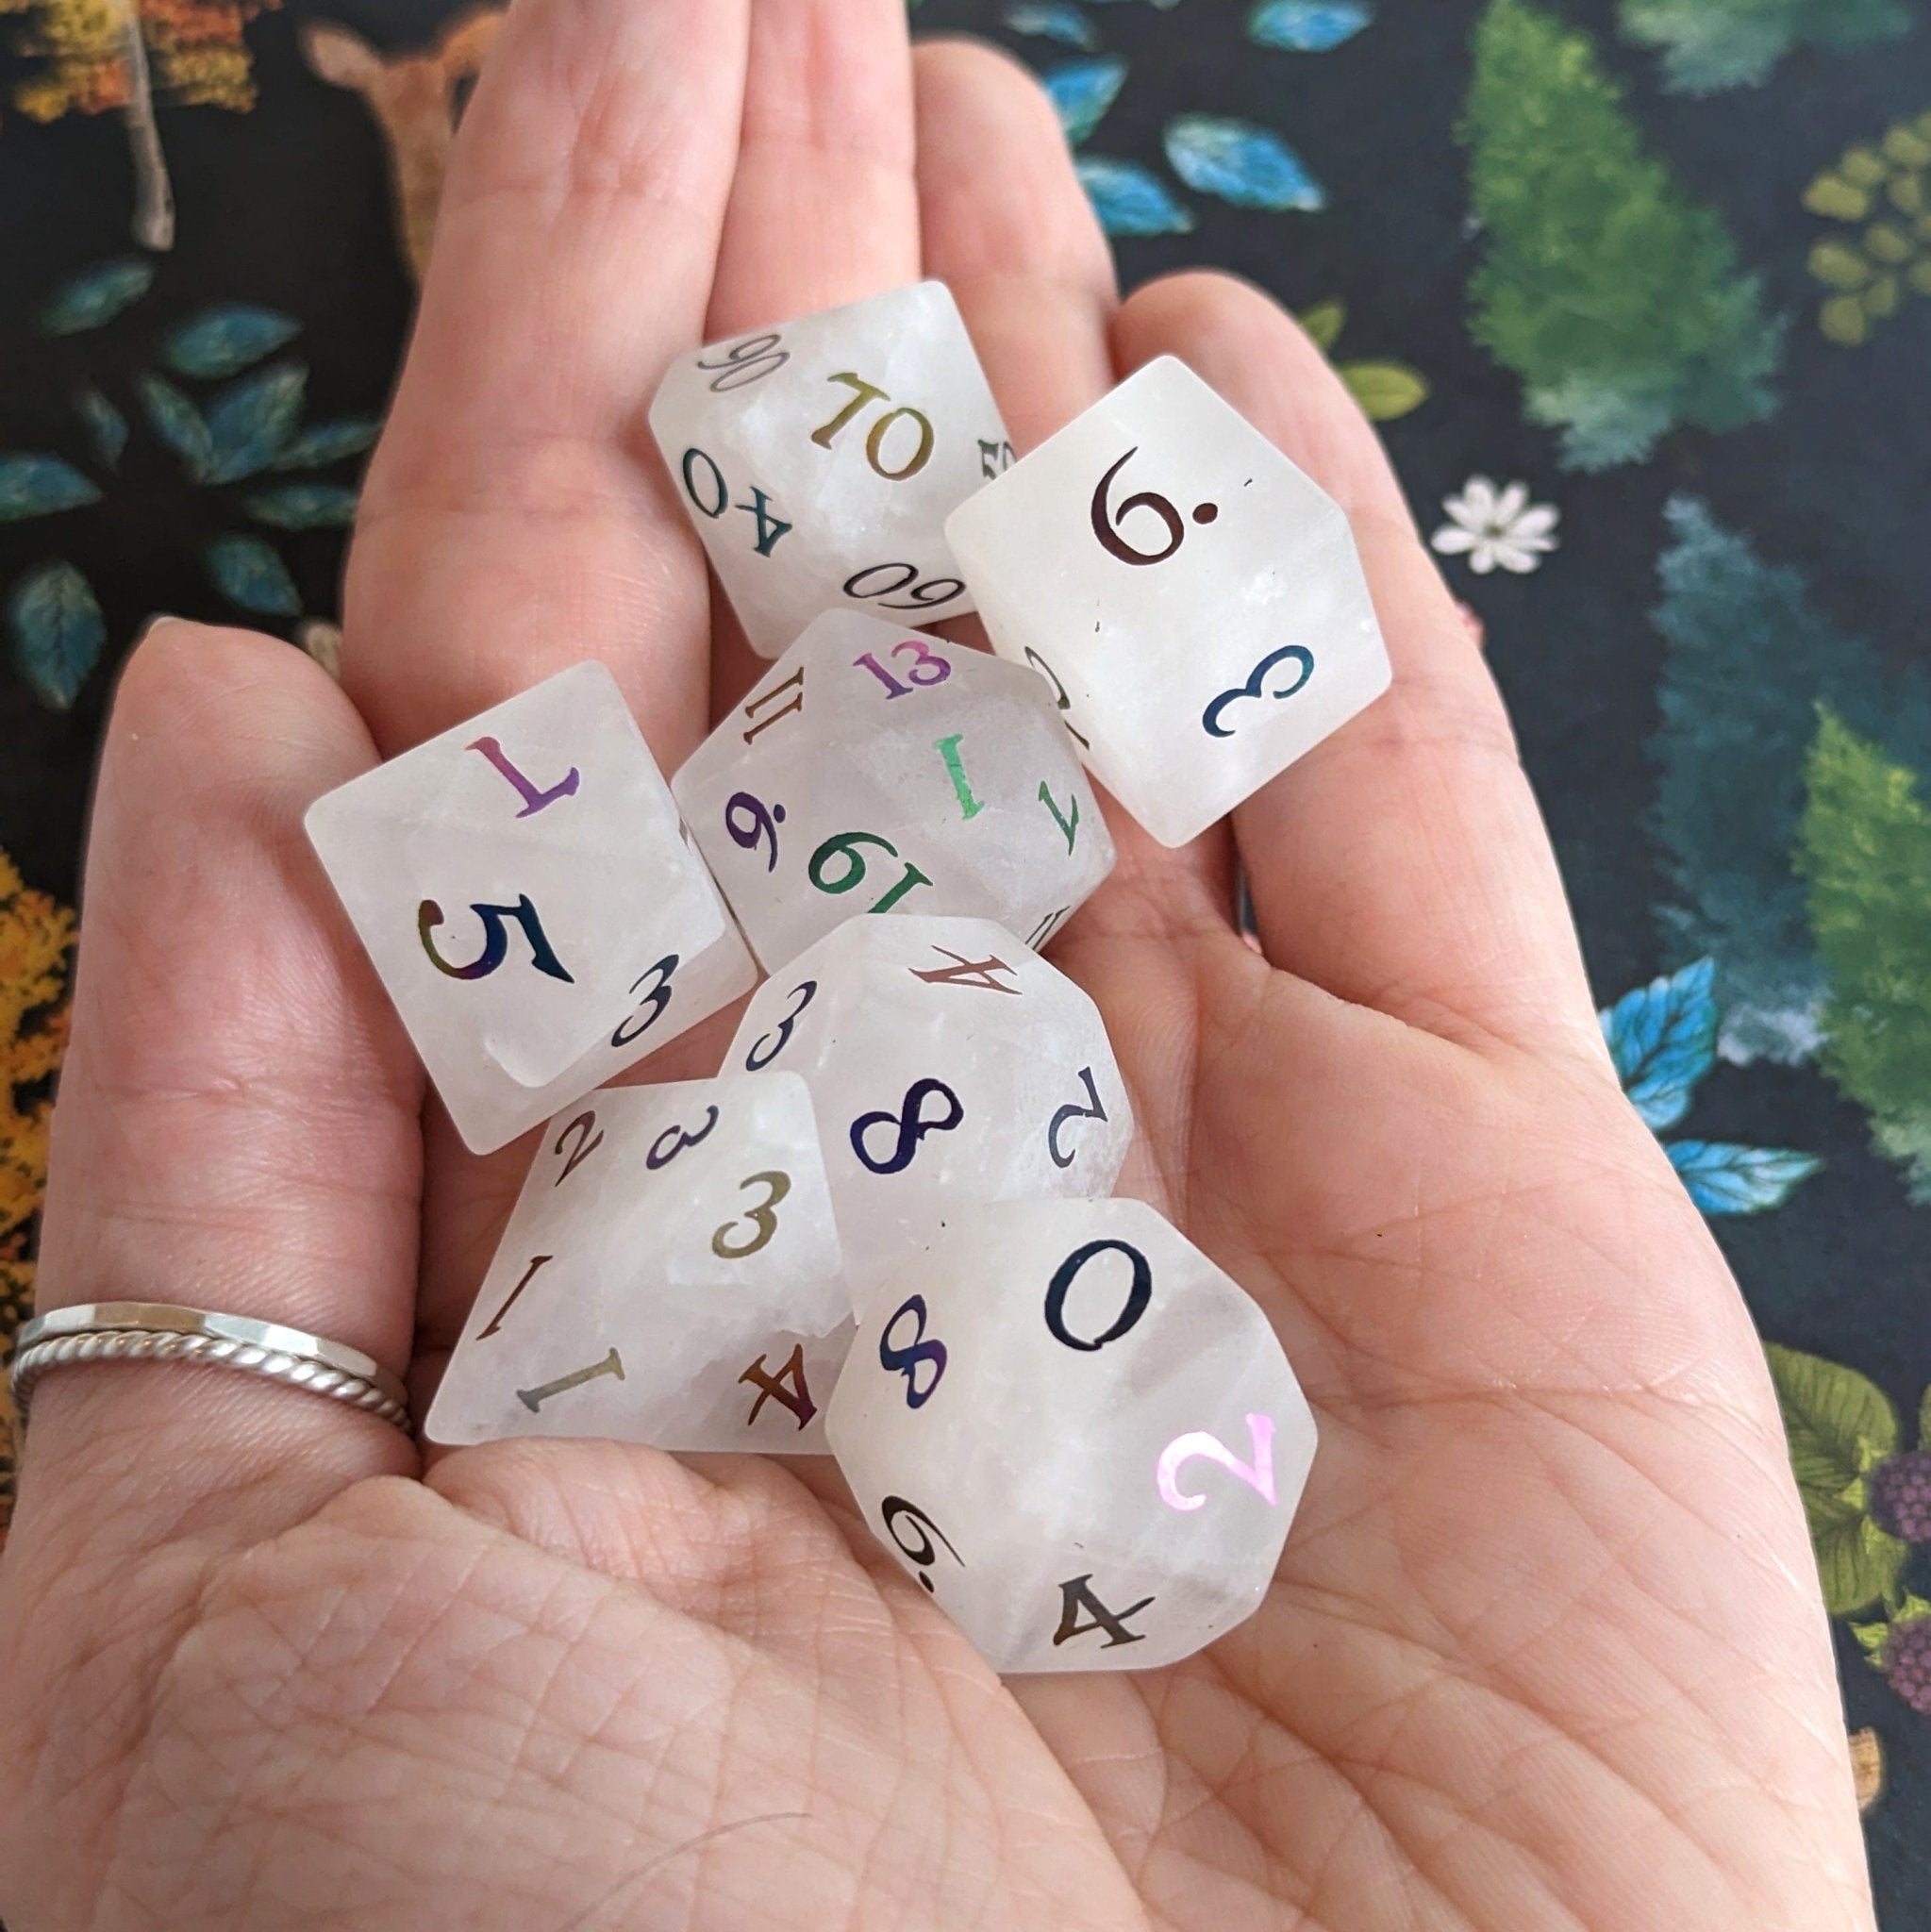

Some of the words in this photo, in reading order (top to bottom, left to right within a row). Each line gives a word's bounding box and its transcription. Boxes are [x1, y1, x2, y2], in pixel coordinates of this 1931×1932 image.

[682, 448, 792, 558] 40
[743, 666, 804, 745] 11
[853, 640, 952, 700] 13
[1202, 645, 1315, 738] 3
[933, 733, 985, 821] 1
[418, 893, 575, 983] 5
[908, 944, 1022, 995] 4
[611, 954, 679, 1047] 3
[745, 980, 817, 1072] 3
[555, 1110, 604, 1187] 2
[646, 1105, 720, 1170] 3
[850, 1077, 964, 1174] 8
[1048, 1066, 1108, 1168] 2
[711, 1170, 791, 1259] 3
[475, 1255, 554, 1341] 1
[1044, 1239, 1152, 1352] 0
[516, 1347, 625, 1413] 1
[738, 1342, 818, 1431] 4
[879, 1293, 947, 1409] 8
[1157, 1412, 1276, 1510] 2
[1053, 1574, 1157, 1649] 4
